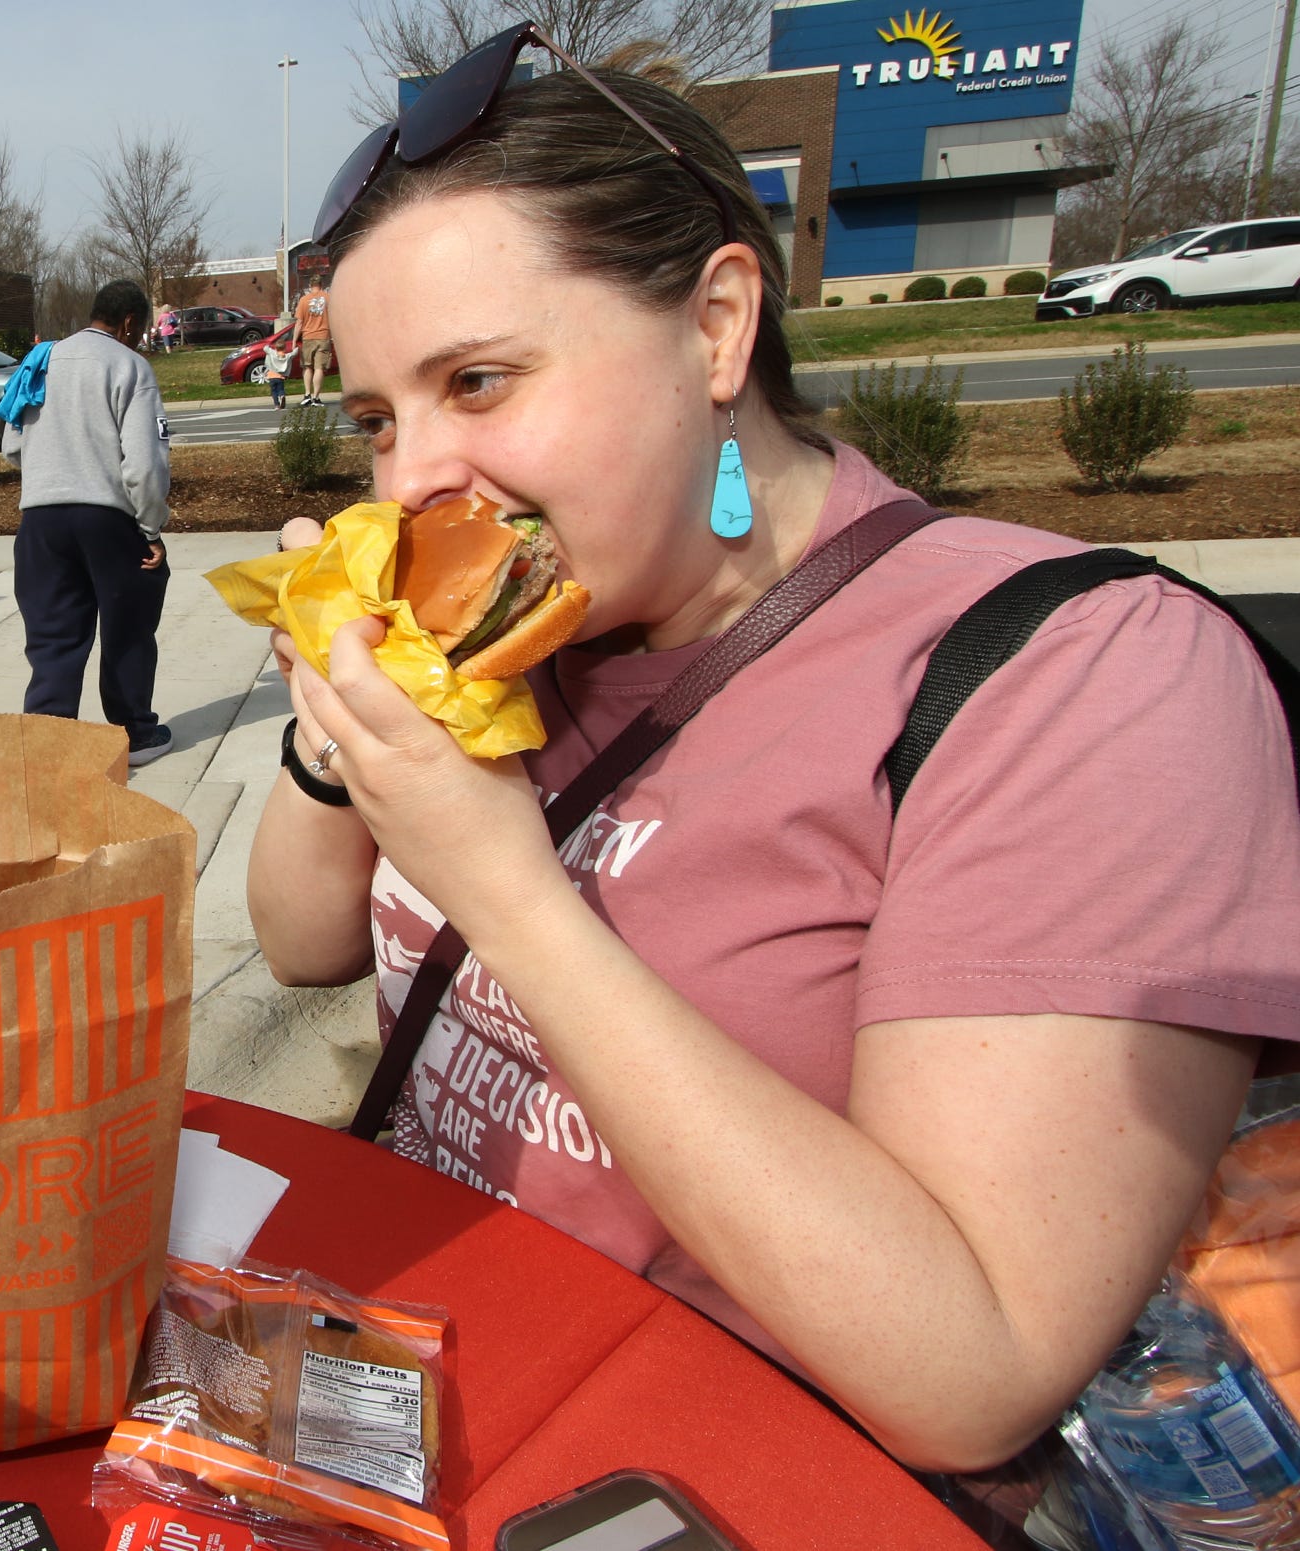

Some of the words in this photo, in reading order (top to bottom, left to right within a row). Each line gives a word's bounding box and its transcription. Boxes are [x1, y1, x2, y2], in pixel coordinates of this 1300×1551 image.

[852, 41, 1071, 86] TRULIANT
[956, 79, 995, 92] Federal
[999, 77, 1032, 88] Credit
[1036, 73, 1067, 84] Union
[453, 995, 549, 1074] WHERE
[438, 1097, 486, 1161] ARE
[305, 1352, 365, 1372] Nutrition
[369, 1365, 407, 1379] Facts
[371, 1382, 397, 1390] cookie
[391, 1395, 419, 1406] 330
[177, 1418, 188, 1428] LLC
[356, 1451, 388, 1467] Potassium
[394, 1453, 411, 1464] 30mg
